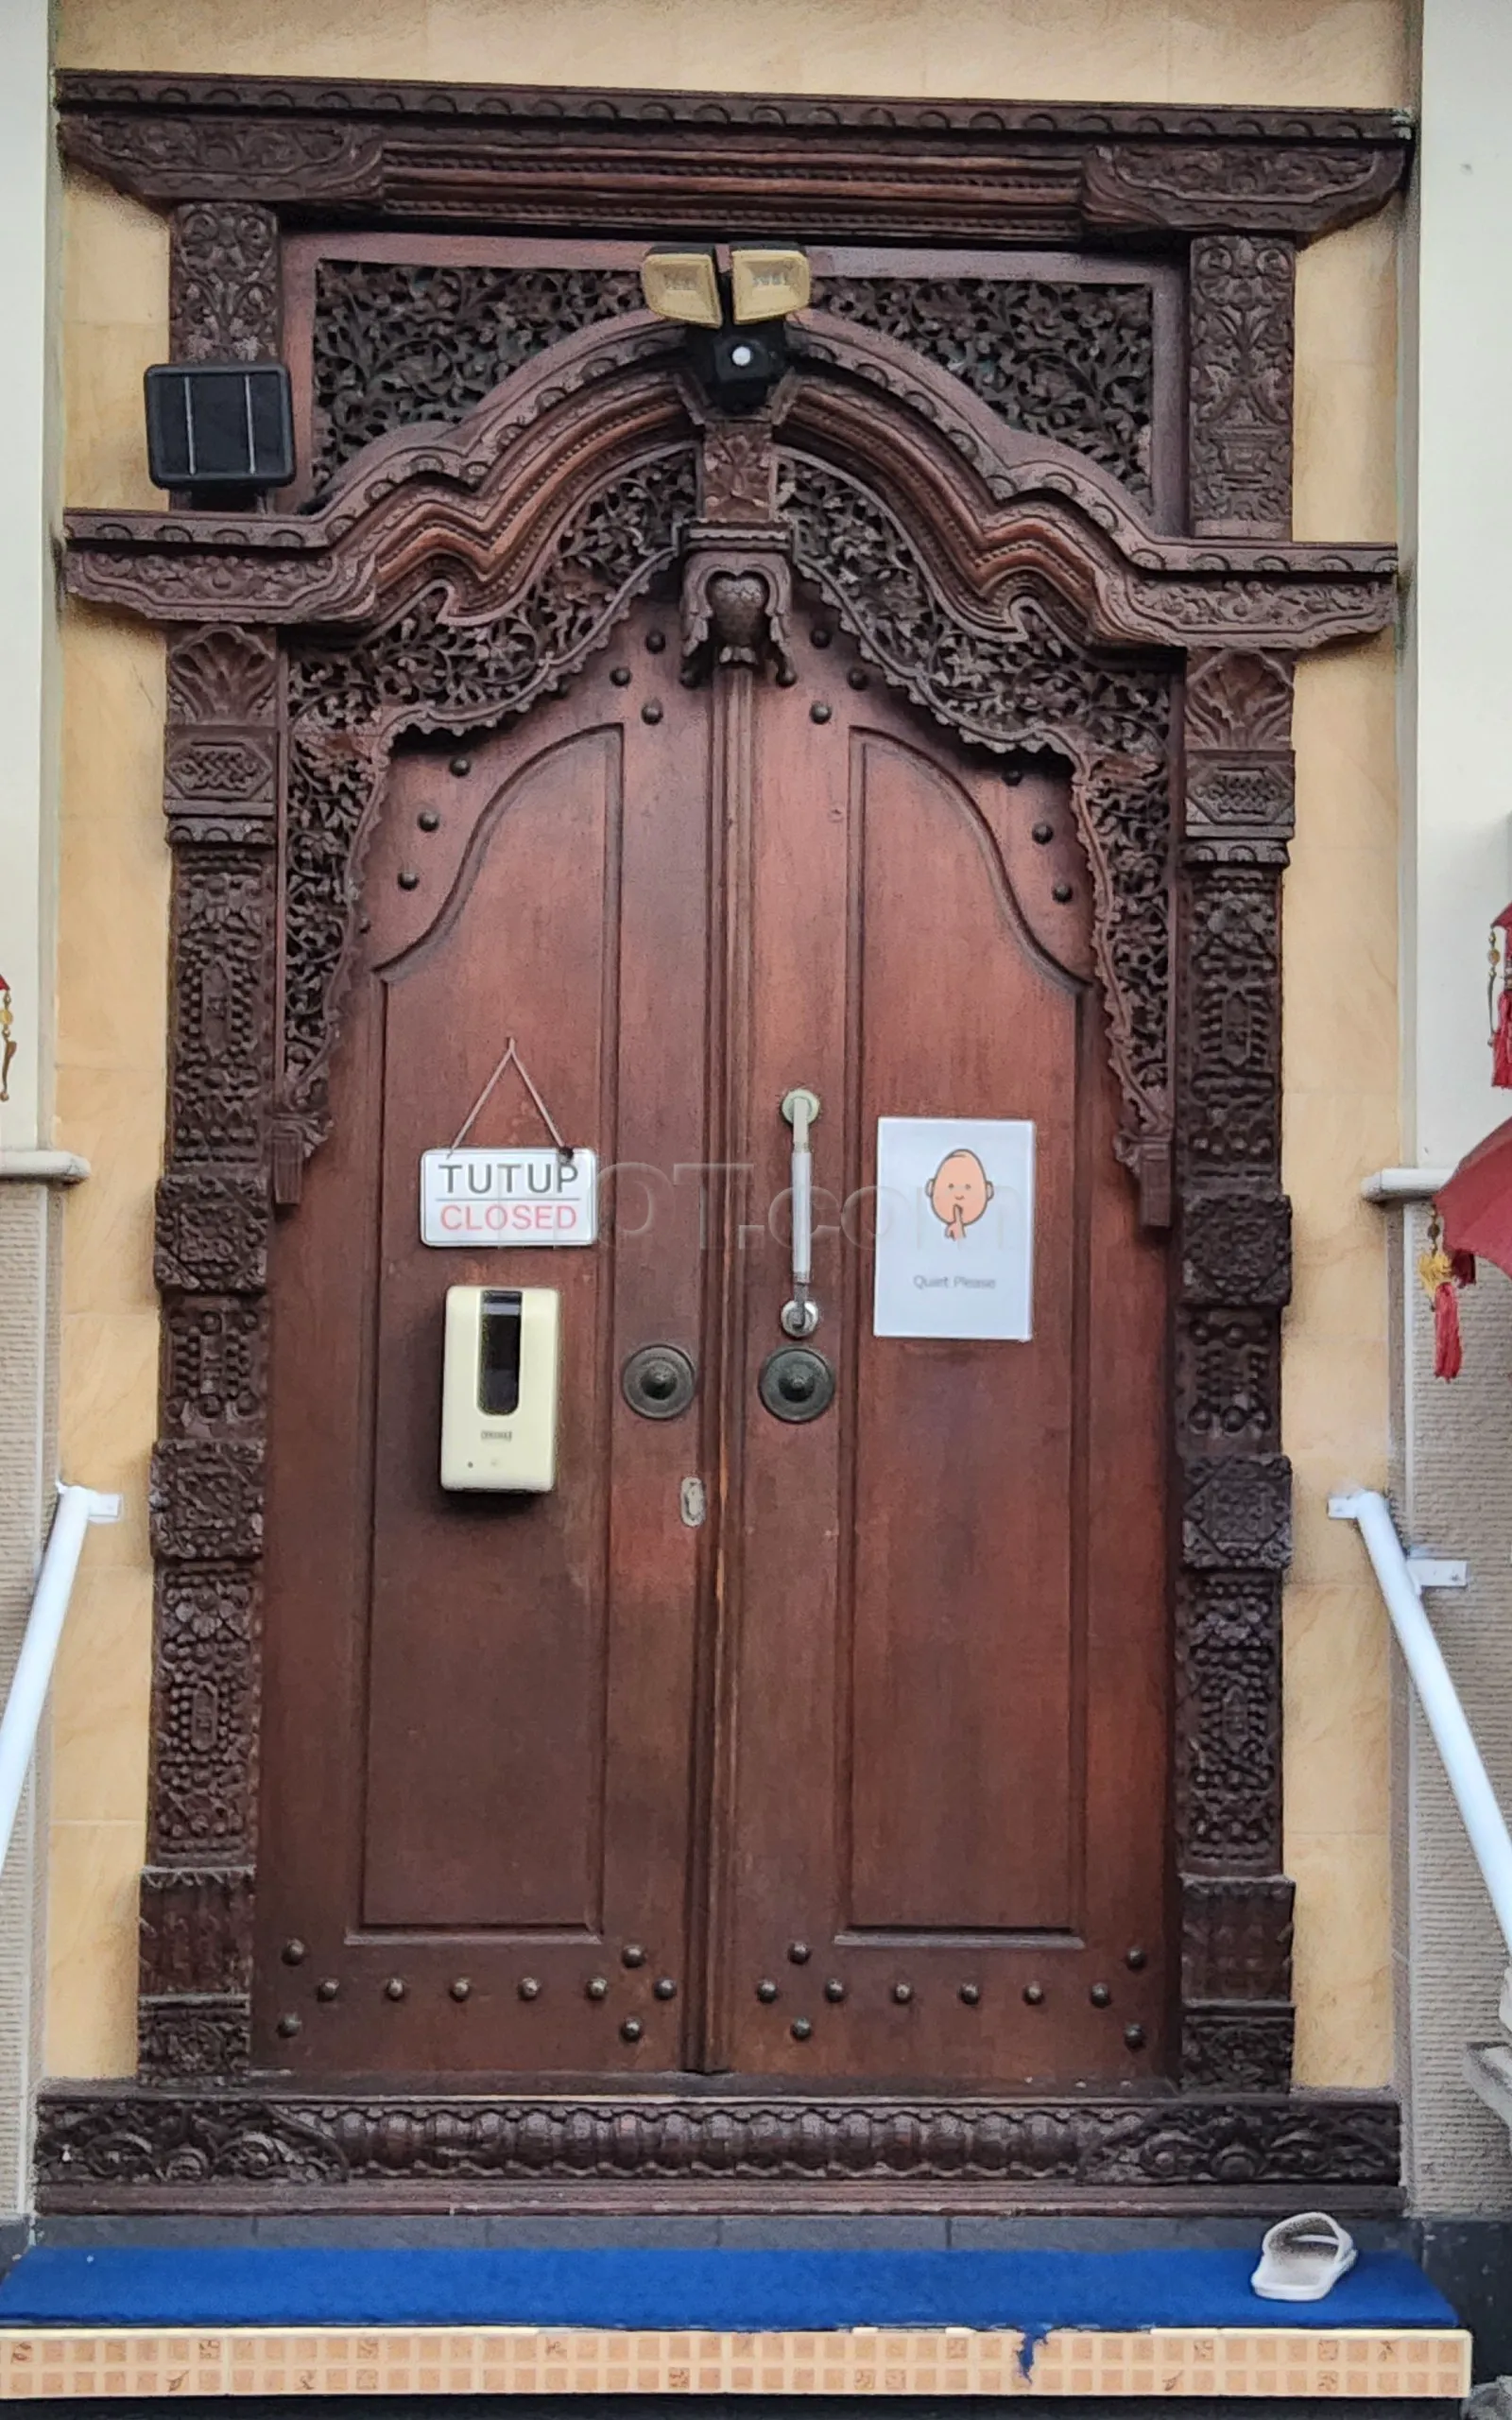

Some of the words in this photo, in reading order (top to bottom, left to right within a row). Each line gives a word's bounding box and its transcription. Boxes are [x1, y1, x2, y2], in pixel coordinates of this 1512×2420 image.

[438, 1164, 579, 1194] TUTUP
[439, 1204, 577, 1230] CLOSED
[913, 1274, 949, 1290] Quiet
[954, 1275, 996, 1289] Please
